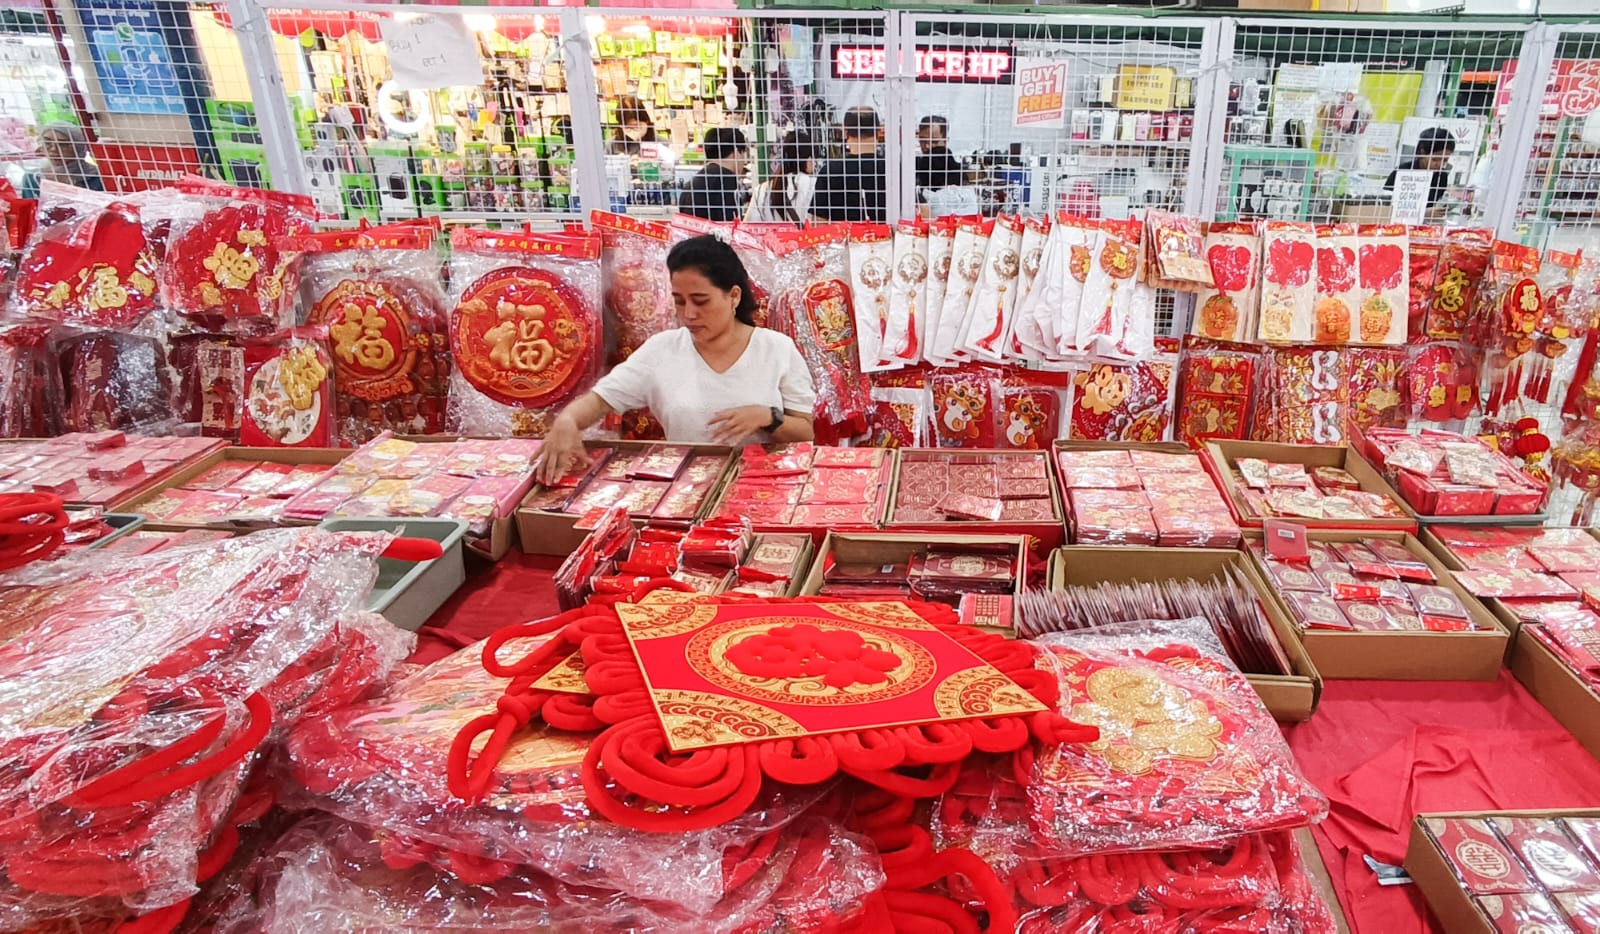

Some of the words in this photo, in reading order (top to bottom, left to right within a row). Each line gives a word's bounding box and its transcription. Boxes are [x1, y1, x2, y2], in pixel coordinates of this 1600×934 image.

[695, 16, 733, 26] VIVAN
[837, 48, 964, 78] SERICE
[967, 52, 1009, 78] HP
[1020, 66, 1055, 86] BUY
[1053, 64, 1066, 93] 1
[1023, 80, 1054, 96] GET
[1017, 92, 1063, 114] FREE
[1401, 182, 1417, 192] OVO
[1433, 267, 1470, 313] 意
[1519, 284, 1540, 313] 福
[482, 301, 555, 373] 福
